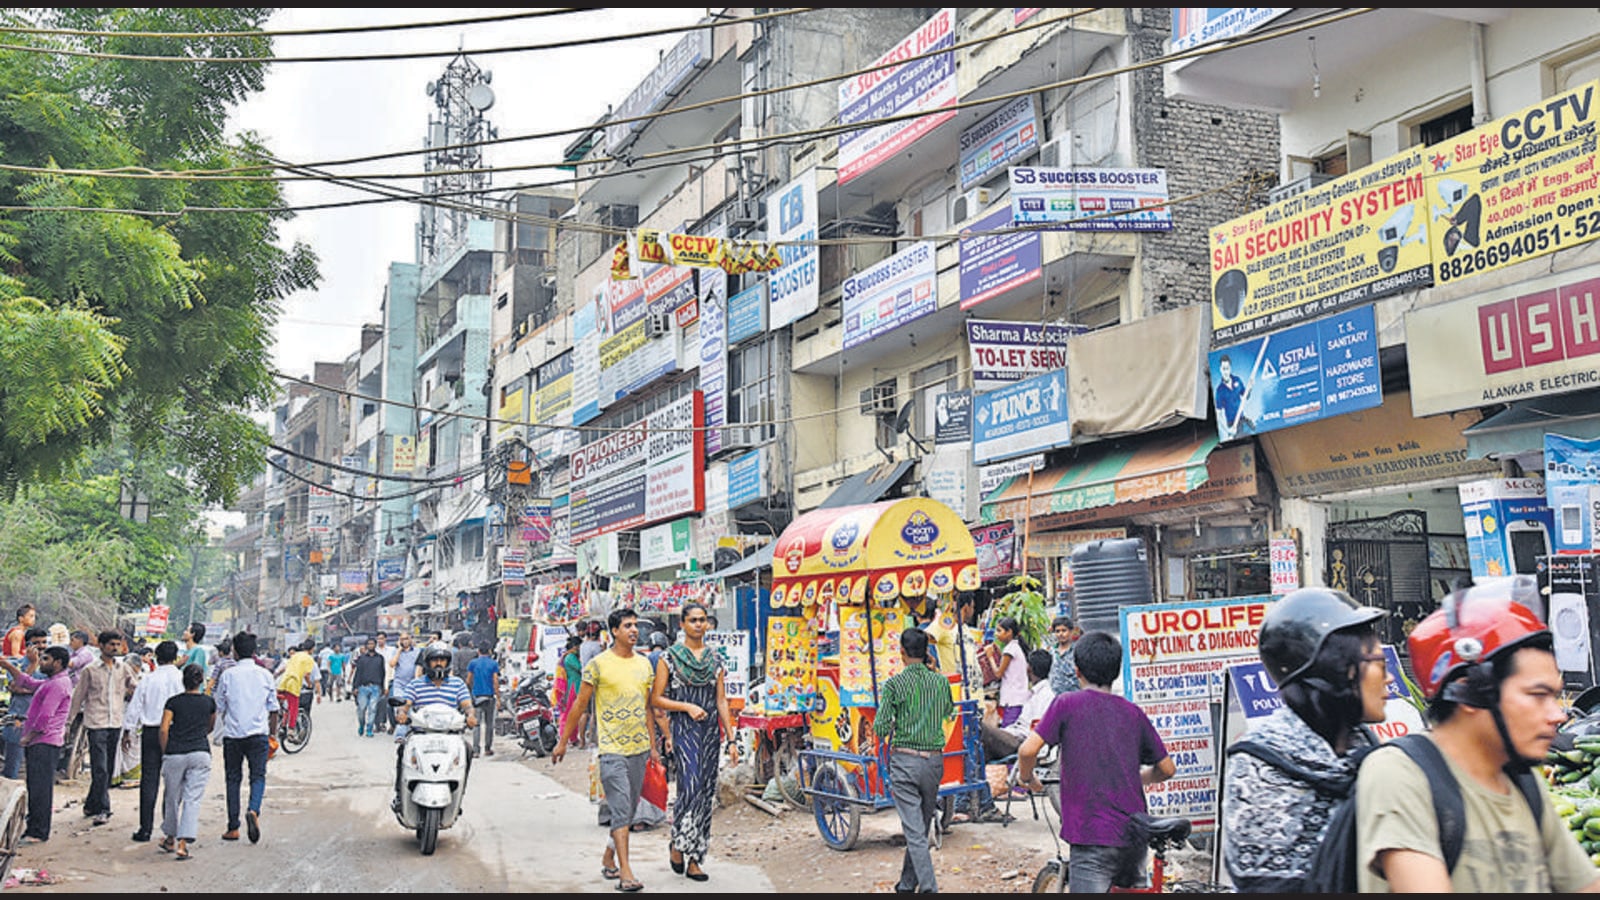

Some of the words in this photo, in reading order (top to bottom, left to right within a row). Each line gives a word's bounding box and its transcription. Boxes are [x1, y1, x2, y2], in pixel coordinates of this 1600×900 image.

[1202, 8, 1247, 39] Sanitary
[857, 39, 911, 95] SUCCESS
[916, 11, 950, 54] HUB
[971, 116, 999, 145] SUCCESS
[1455, 142, 1477, 162] Star
[1479, 133, 1499, 156] Eye
[1501, 86, 1594, 150] CCTV
[1039, 172, 1097, 184] SUCCESS
[1100, 172, 1159, 185] BOOSTER
[779, 183, 803, 235] CB
[1214, 242, 1239, 271] SAI
[1245, 207, 1334, 261] SECURITY
[1341, 172, 1424, 226] SYSTEM
[1232, 221, 1247, 237] Star
[1249, 216, 1263, 233] Eye
[1283, 199, 1303, 218] CCTV
[1485, 210, 1553, 243] Admission
[1556, 195, 1594, 217] Open
[671, 235, 717, 254] CCTV
[679, 250, 709, 261] AMC
[1309, 228, 1356, 254] INSTALLATION
[857, 265, 891, 294] SUCCESS
[891, 245, 929, 276] BOOSTER
[1319, 246, 1346, 270] SYSTEM
[1253, 282, 1276, 299] ACCESS
[1307, 261, 1346, 285] ELECTRONIC
[1347, 253, 1366, 272] LOCK
[1273, 290, 1296, 310] SYSTEM
[1305, 285, 1316, 299] ALL
[1318, 273, 1350, 296] SECURITY
[1350, 264, 1379, 284] DEVICES
[1322, 296, 1337, 309] GAS
[1338, 286, 1369, 304] AGENCY
[972, 324, 1020, 342] Sharma
[1327, 330, 1369, 351] SANITARY
[1487, 292, 1600, 362] USH
[975, 348, 1026, 368] TO-LET
[1030, 350, 1067, 368] SERV
[1278, 343, 1319, 366] ASTRAL
[1325, 355, 1375, 379] HARDWARE
[1345, 349, 1353, 360] &
[1279, 364, 1300, 376] PIPES
[1336, 372, 1366, 389] STORE
[1482, 381, 1535, 401] ALANKAR
[1540, 369, 1600, 391] ELECTRIC
[991, 387, 1042, 426] PRINCE
[587, 424, 647, 465] PIONEER
[588, 442, 645, 474] ACADEMY
[1309, 465, 1361, 484] SANITARY
[1363, 464, 1373, 476] &
[1374, 454, 1444, 475] HARDWARE
[1444, 448, 1467, 464] STO
[1141, 604, 1266, 635] UROLIFE
[1131, 635, 1194, 658] POLYCLINIC
[1197, 632, 1207, 651] &
[1208, 628, 1261, 650] DIAGNOS
[1174, 713, 1202, 728] SINHA
[1167, 778, 1211, 792] SPECIALIST
[1167, 789, 1217, 806] PRASHANT
